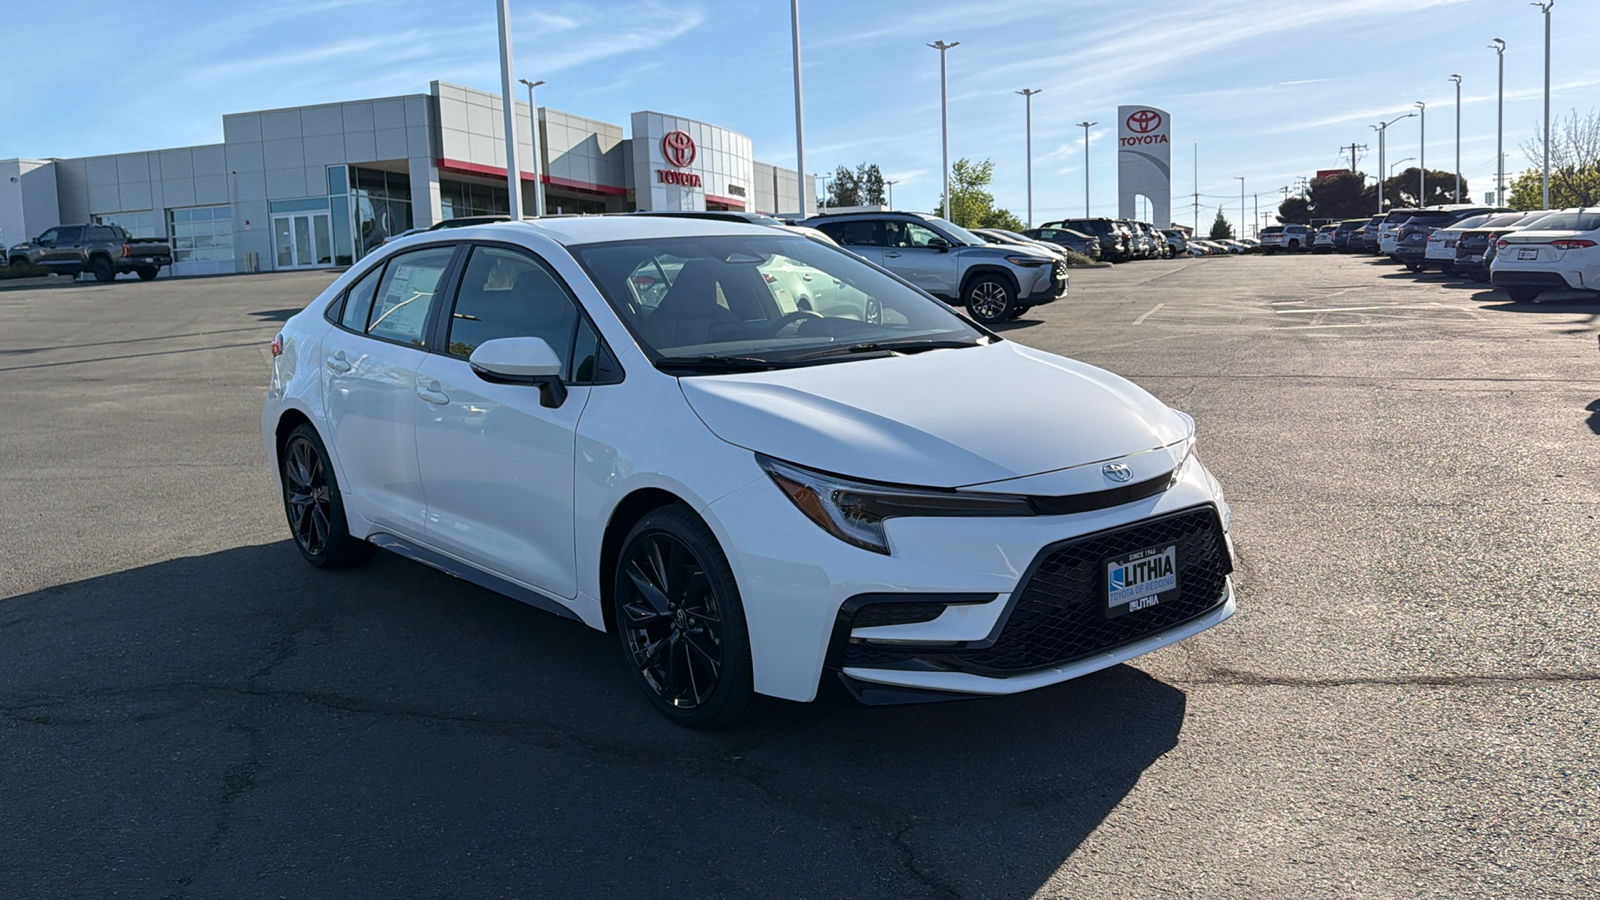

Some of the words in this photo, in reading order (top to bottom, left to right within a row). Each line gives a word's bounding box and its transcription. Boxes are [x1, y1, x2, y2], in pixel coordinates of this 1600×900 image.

[1120, 134, 1168, 147] TOYOTA
[657, 169, 702, 188] TOYOTA
[1128, 550, 1144, 561] SINCE
[1124, 555, 1173, 587] LITHIA
[1110, 589, 1134, 602] TOYOTA
[1135, 584, 1144, 595] OF
[1145, 576, 1174, 591] REDDING
[1136, 594, 1159, 610] LITHIA
